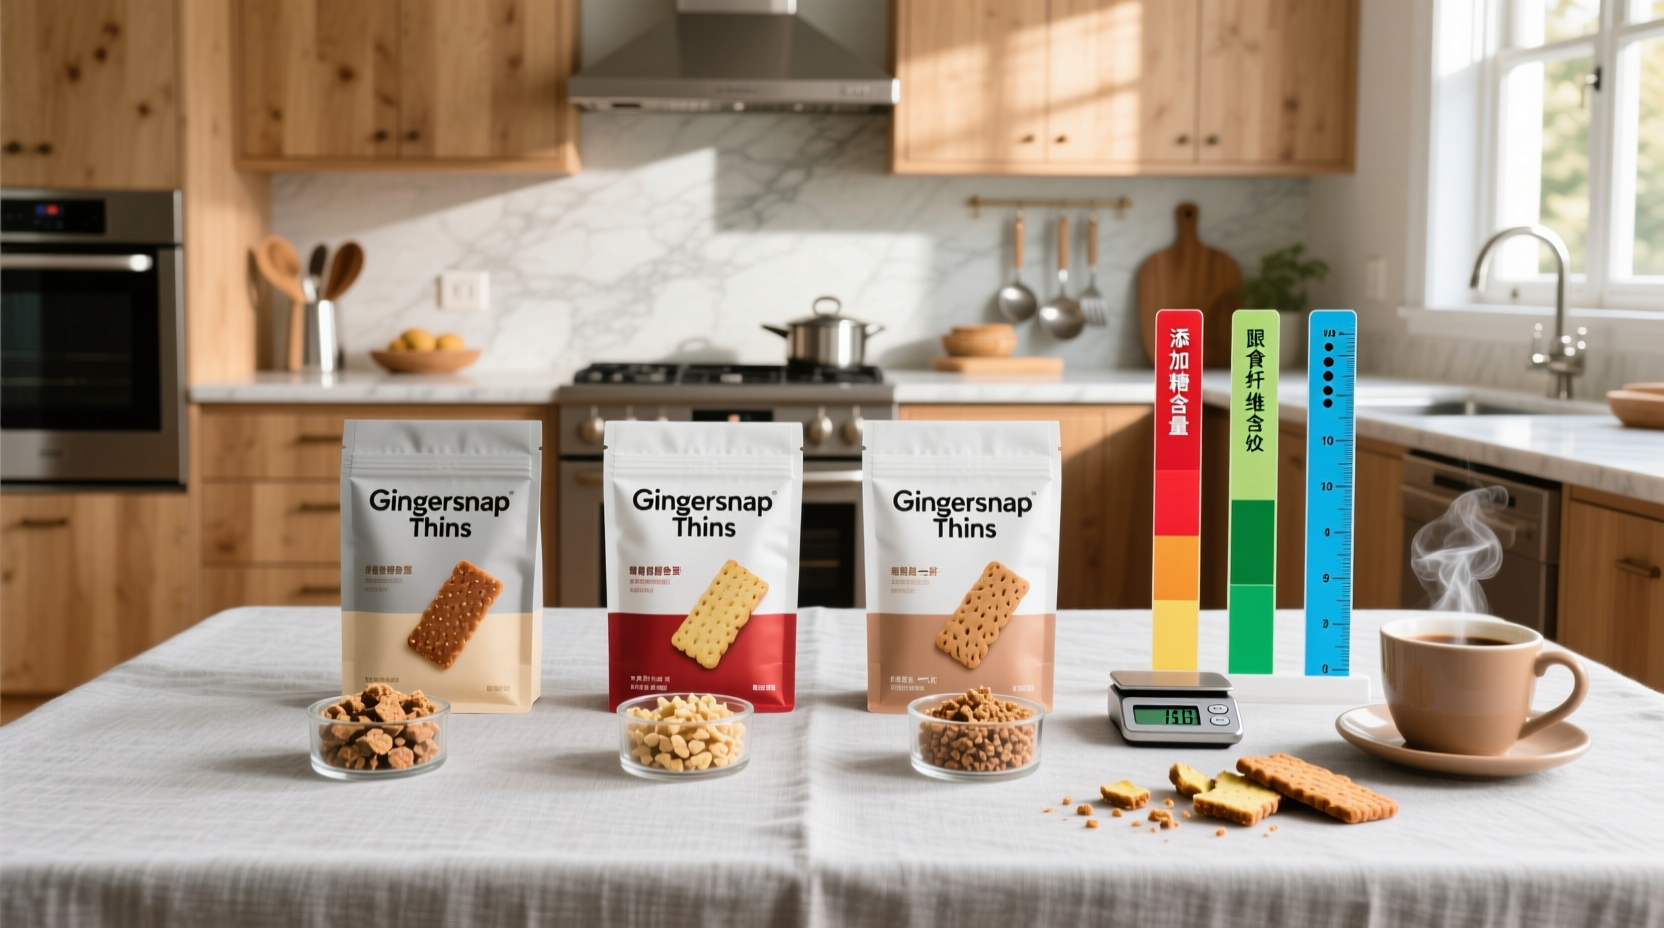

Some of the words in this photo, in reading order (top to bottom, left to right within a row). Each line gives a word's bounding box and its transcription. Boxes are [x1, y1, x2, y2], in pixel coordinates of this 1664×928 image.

[1322, 435, 1334, 446] 10
[369, 488, 511, 517] Gingersnap
[632, 488, 773, 517] Gingersnap
[892, 489, 1033, 518] Gingersnap
[409, 515, 472, 538] Thins
[672, 515, 736, 538] Thins
[932, 516, 997, 539] Thins
